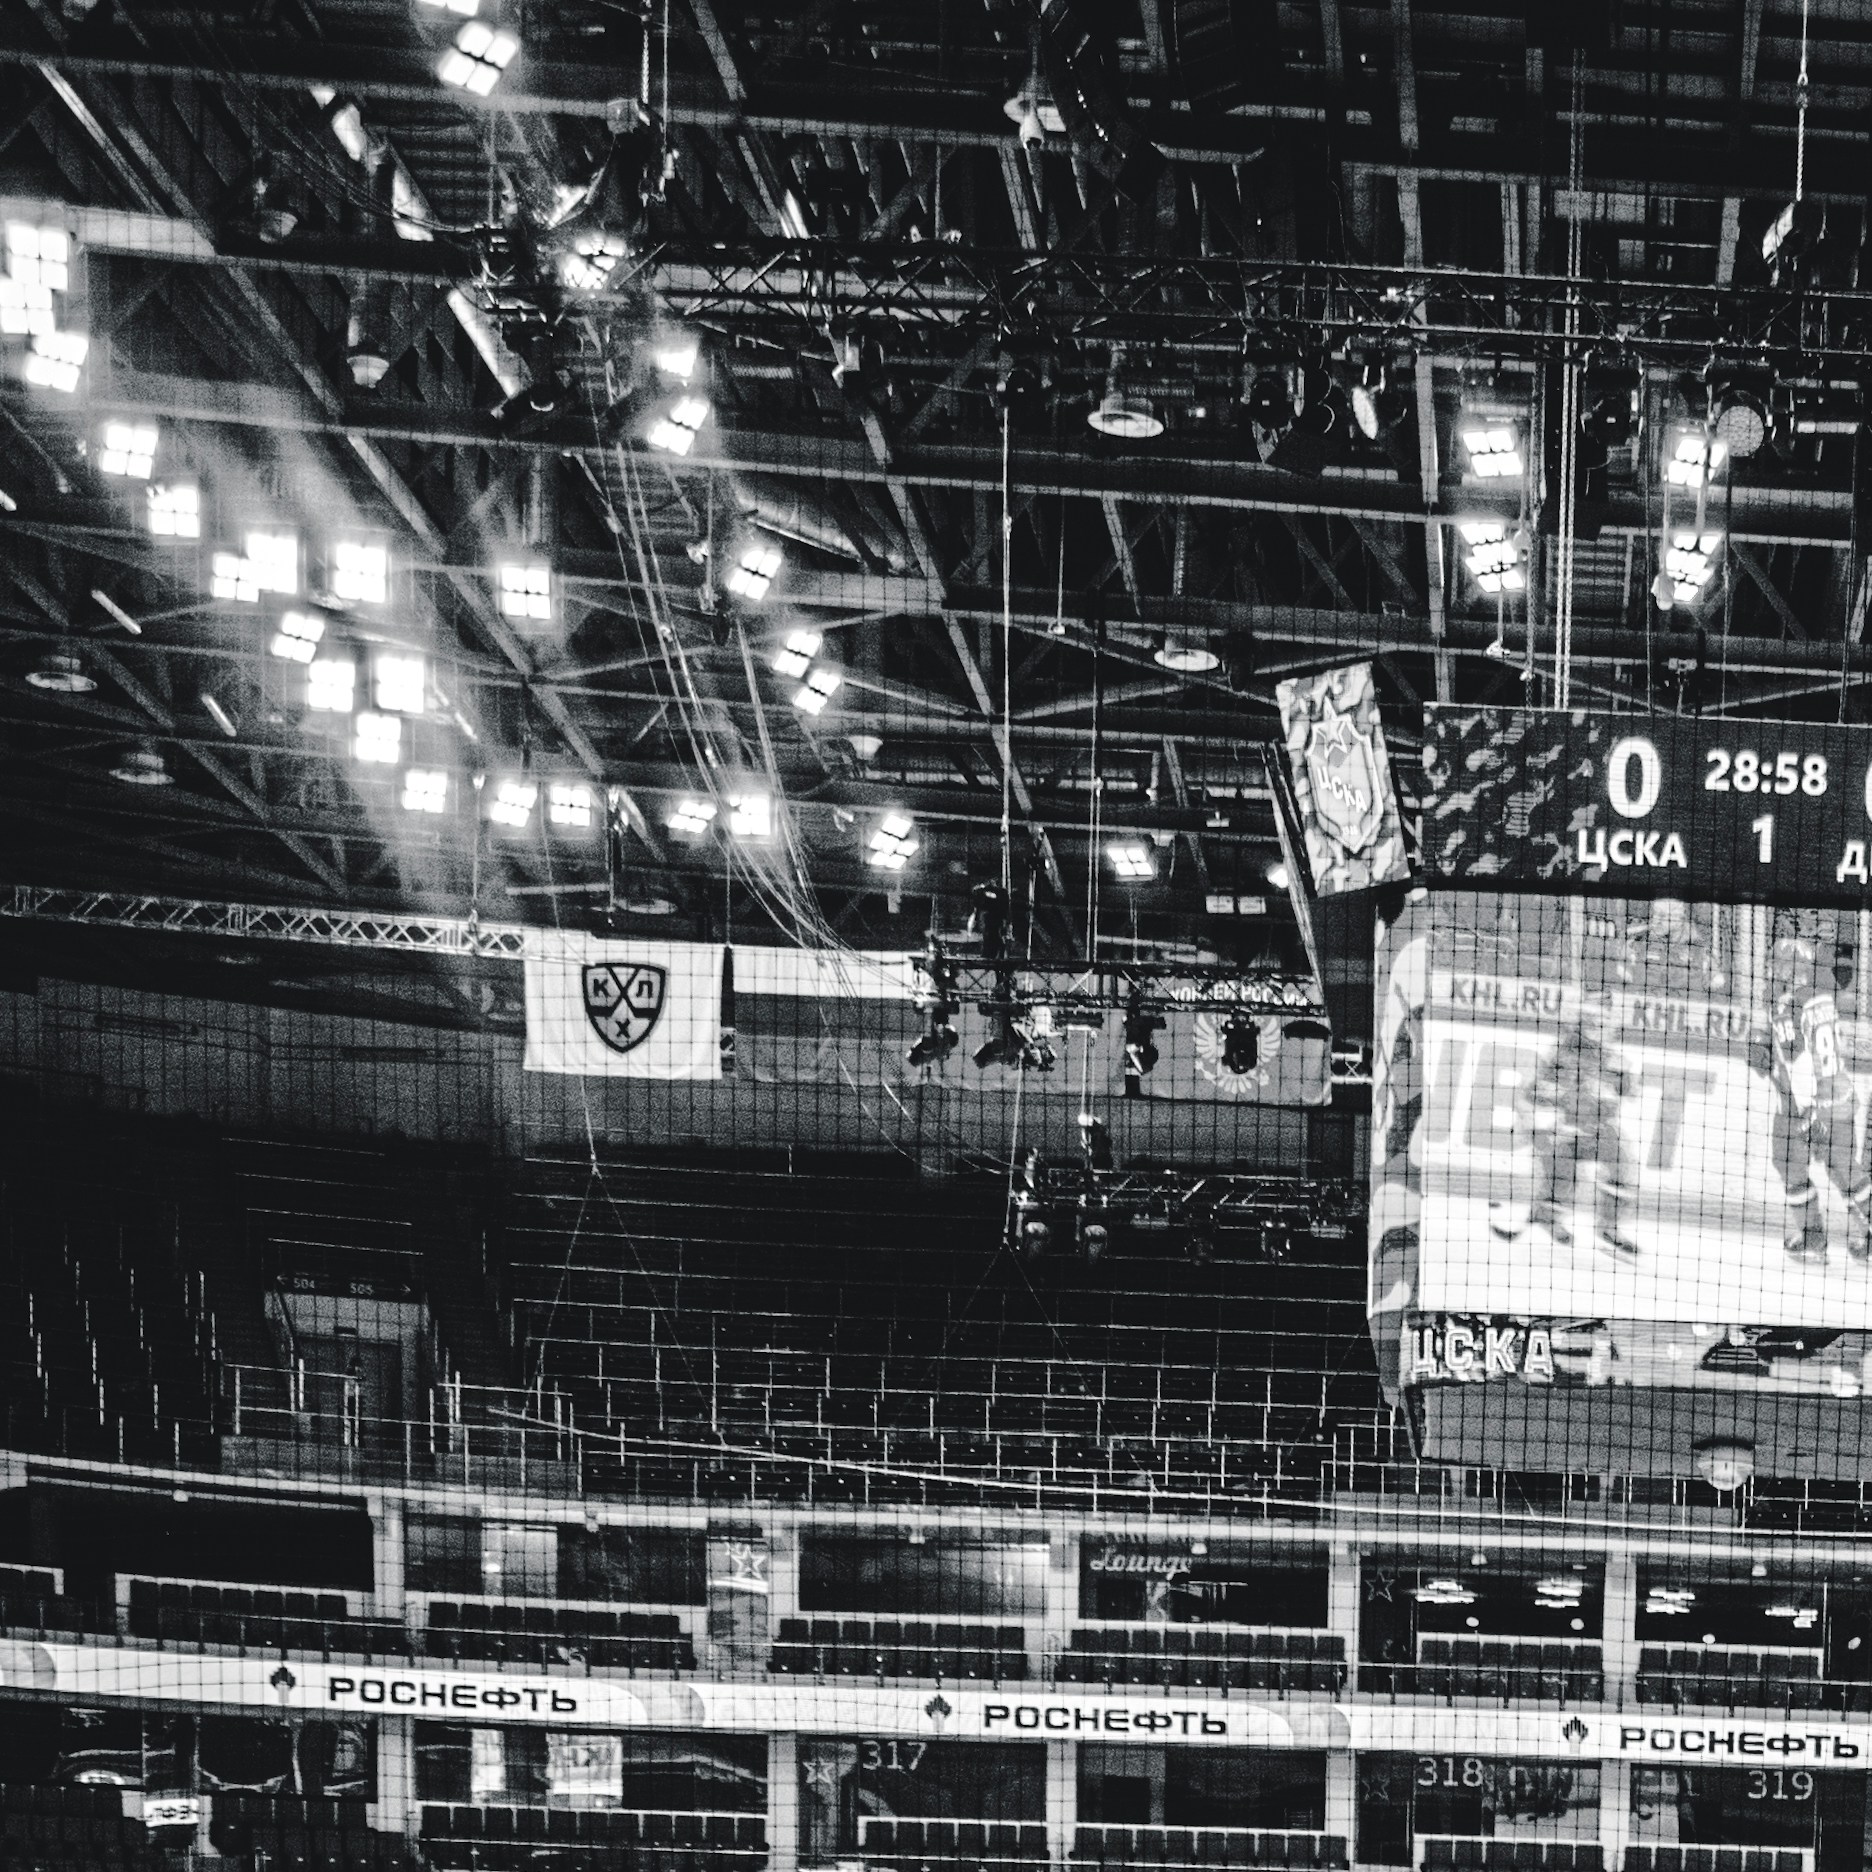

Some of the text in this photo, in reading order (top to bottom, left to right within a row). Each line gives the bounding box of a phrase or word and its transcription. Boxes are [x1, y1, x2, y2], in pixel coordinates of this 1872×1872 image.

[1317, 766, 1367, 814] ЦСКА
[1607, 737, 1662, 816] 0
[1705, 750, 1827, 796] 28:58
[1578, 826, 1687, 872] ЦСКА
[1751, 817, 1773, 862] 1
[1452, 978, 1562, 1014] KHL.RU
[1633, 1001, 1748, 1038] KHL.RU
[1410, 1327, 1553, 1382] ЦСКА
[1090, 1549, 1194, 1580] Lounge
[330, 1677, 577, 1713] РОСНЕФТЬ
[983, 1704, 1228, 1736] РОСНЕФТЬ
[862, 1741, 926, 1772] 317
[1620, 1727, 1860, 1760] РОСНЕФТЬ
[1417, 1757, 1485, 1788] 318
[1747, 1771, 1814, 1801] 319
